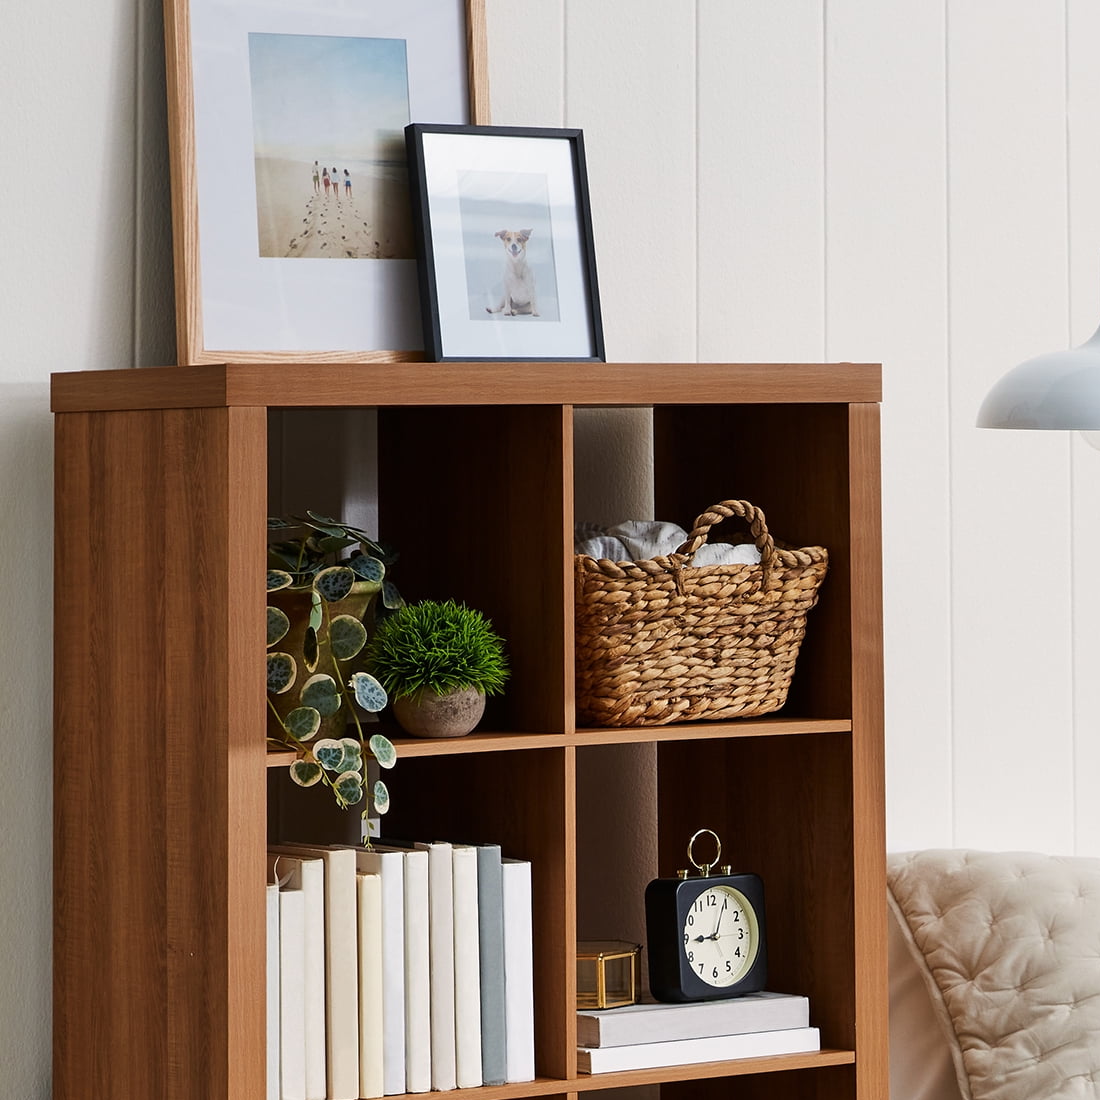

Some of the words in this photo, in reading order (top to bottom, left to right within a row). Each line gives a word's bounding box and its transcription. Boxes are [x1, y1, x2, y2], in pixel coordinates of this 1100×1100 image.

[694, 900, 703, 912] 11
[706, 895, 717, 906] 12
[733, 910, 739, 922] 2
[737, 928, 744, 939] 3
[688, 951, 694, 962] 8
[734, 946, 741, 957] 4
[698, 963, 704, 974] 7
[725, 961, 731, 972] 5
[712, 967, 718, 978] 6
